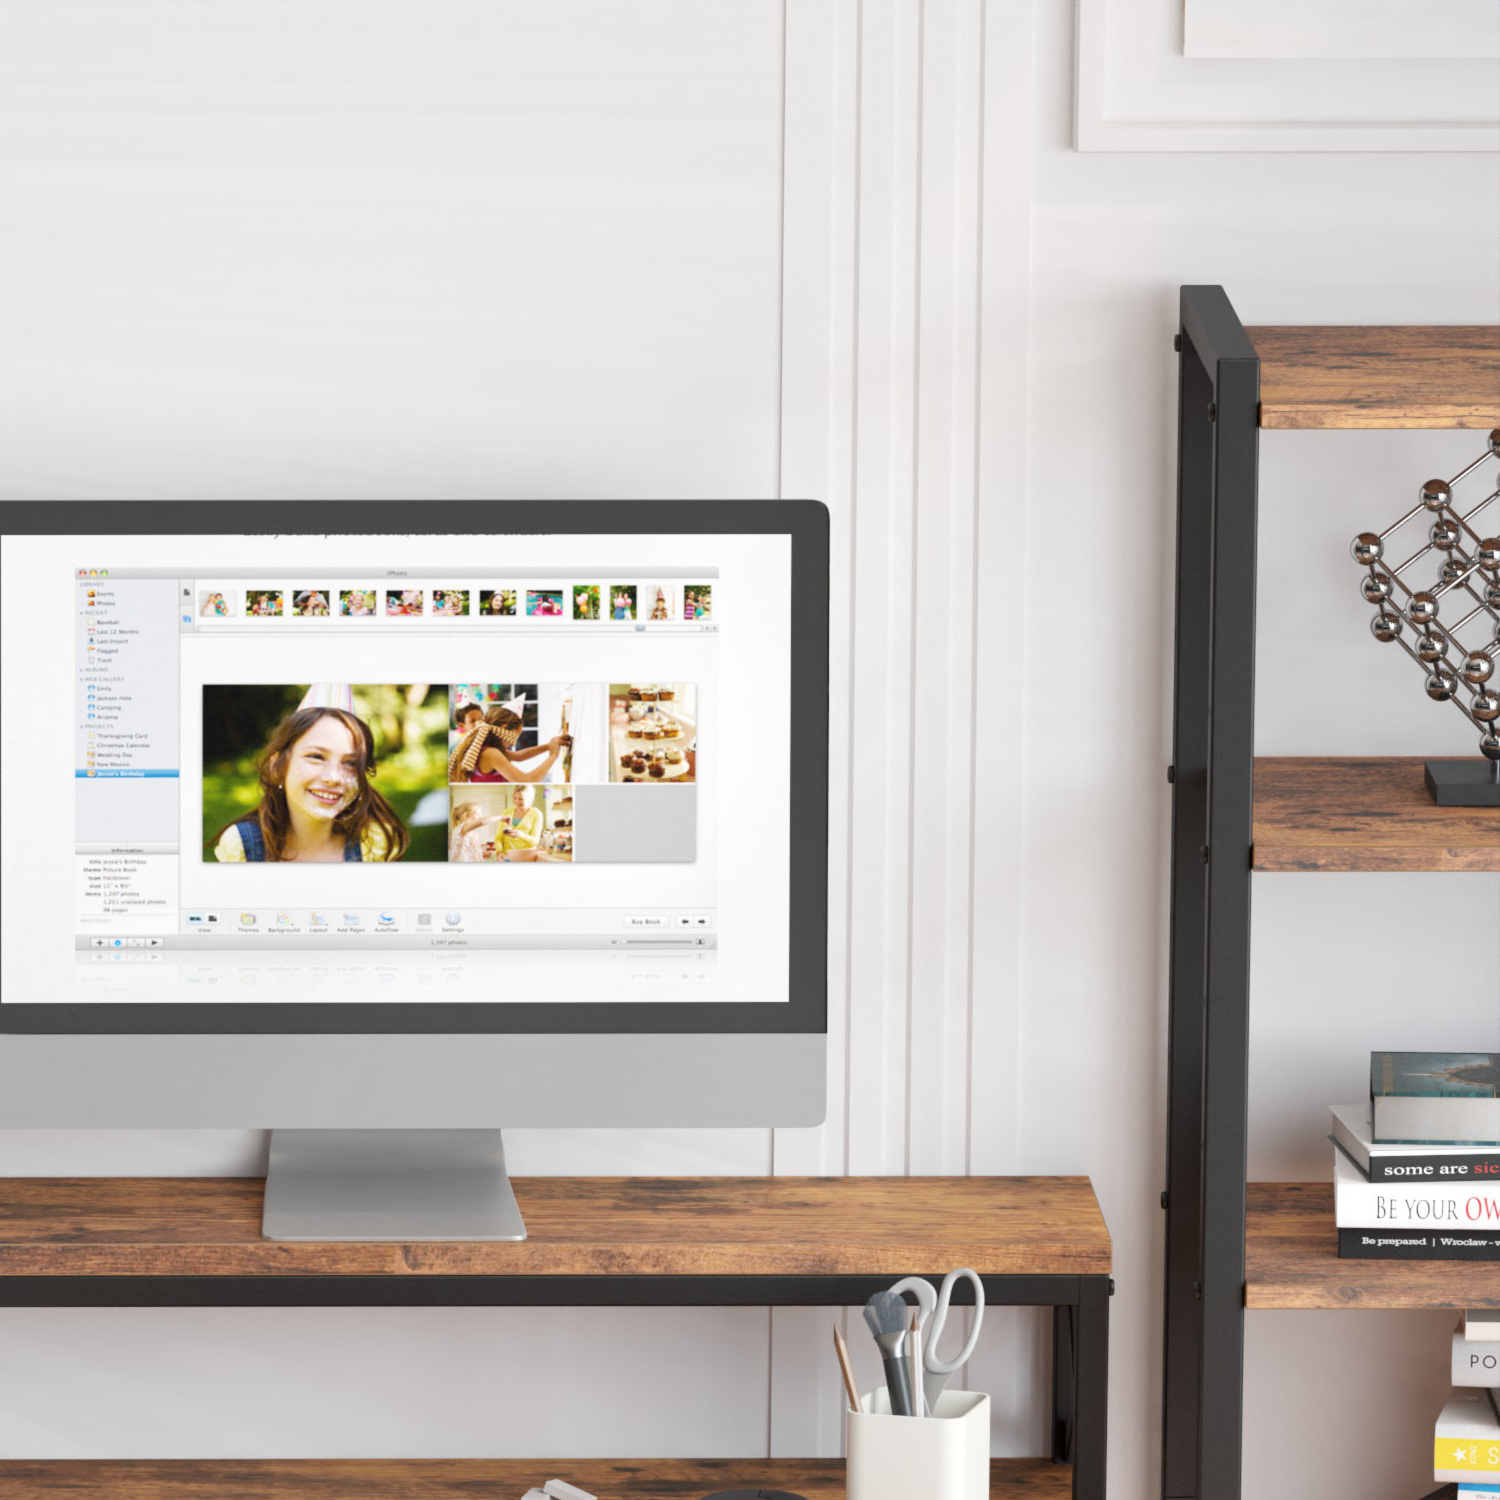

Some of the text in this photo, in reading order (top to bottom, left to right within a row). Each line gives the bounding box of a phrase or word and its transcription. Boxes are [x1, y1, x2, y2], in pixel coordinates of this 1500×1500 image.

[1384, 1166, 1434, 1176] some
[1439, 1165, 1468, 1174] are
[1405, 1199, 1459, 1220] YOUR
[1362, 1237, 1376, 1245] Be
[1377, 1238, 1427, 1246] prepared
[1440, 1238, 1487, 1246] Wroclaw
